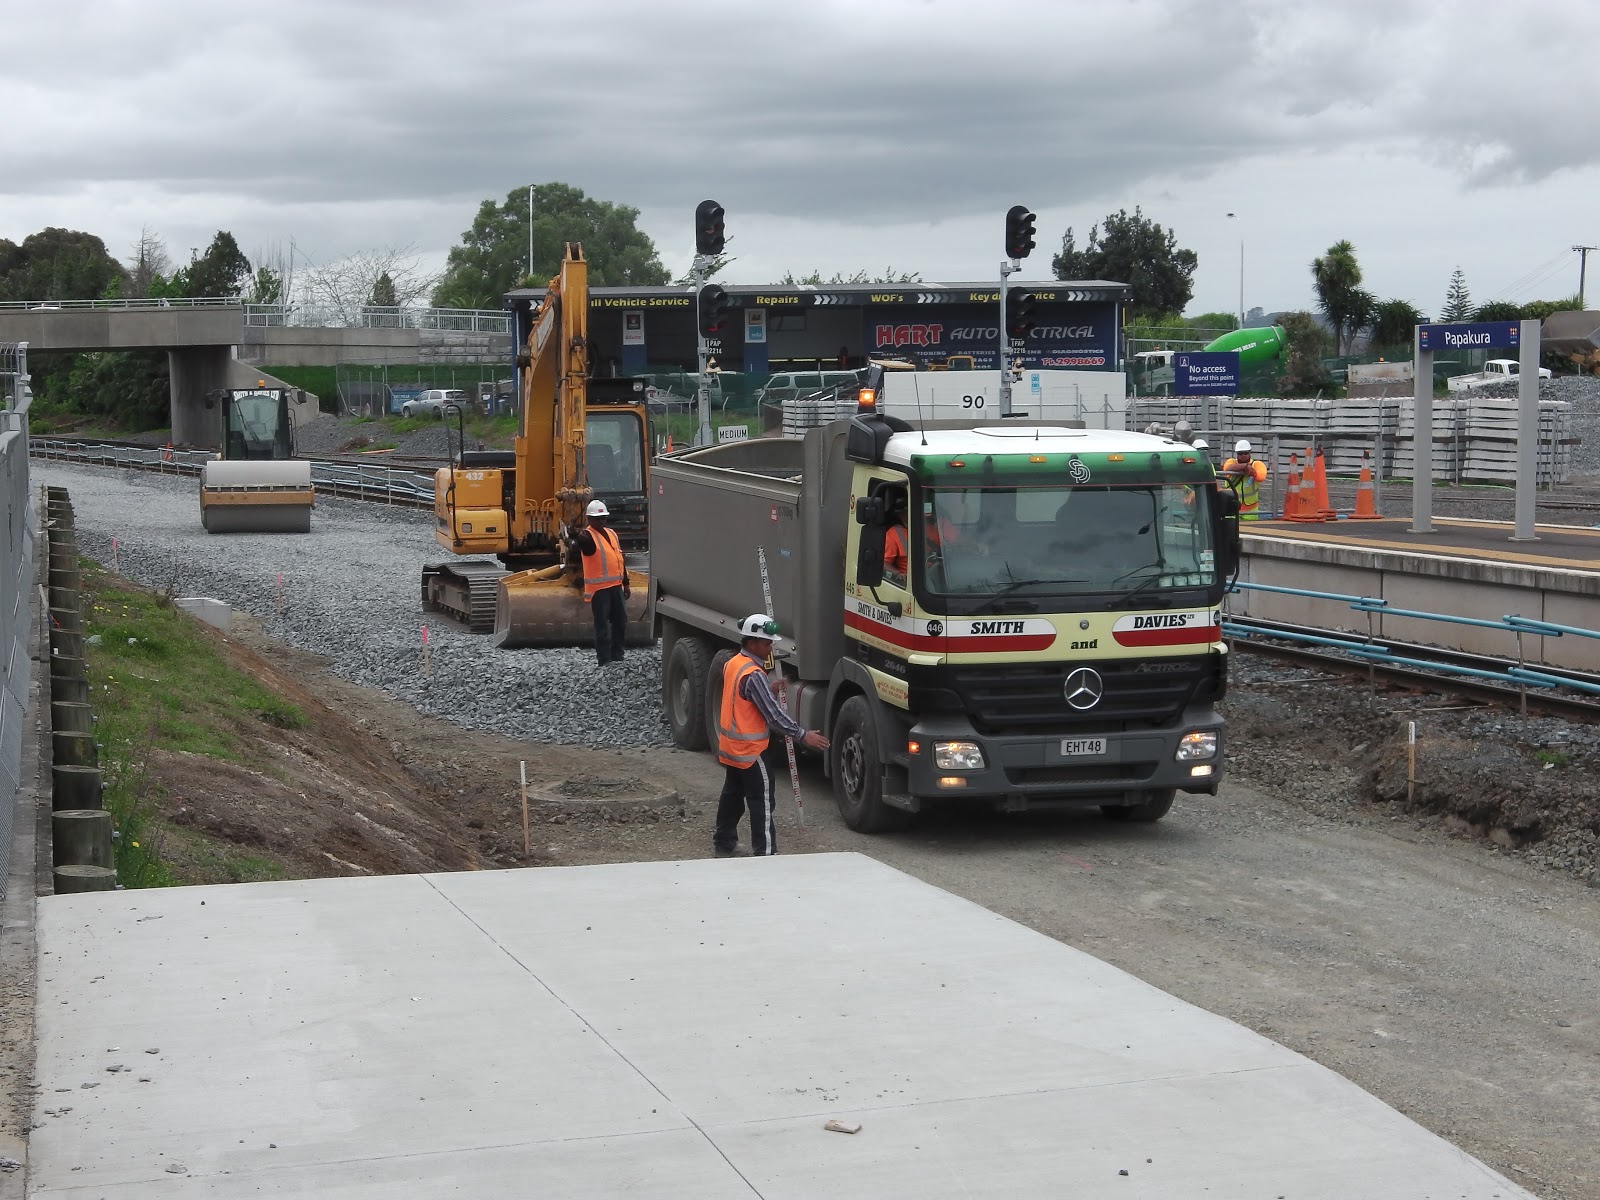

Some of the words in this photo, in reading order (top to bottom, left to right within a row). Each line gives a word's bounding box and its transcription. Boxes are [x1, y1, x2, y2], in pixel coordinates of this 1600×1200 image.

[604, 298, 647, 307] Vehicle
[649, 297, 690, 306] Service
[756, 295, 799, 305] Repairs
[871, 294, 904, 302] WOF's
[969, 293, 990, 303] Key
[876, 324, 944, 348] HART
[950, 327, 999, 340] AUTO
[1029, 326, 1096, 339] CTRICAL
[1444, 330, 1491, 348] Papakura
[1056, 356, 1105, 366] 2998669
[1189, 365, 1201, 373] No
[962, 395, 985, 410] 90
[719, 428, 747, 440] MEDIUM
[465, 472, 484, 481] 432
[857, 602, 872, 617] SMITH
[876, 610, 893, 625] DAVIES
[1133, 614, 1187, 629] DAVIES
[927, 623, 944, 633] 446
[970, 621, 1025, 634] SMITH
[1070, 639, 1099, 650] and
[884, 659, 906, 674] 2646
[1065, 740, 1102, 753] EHT48
